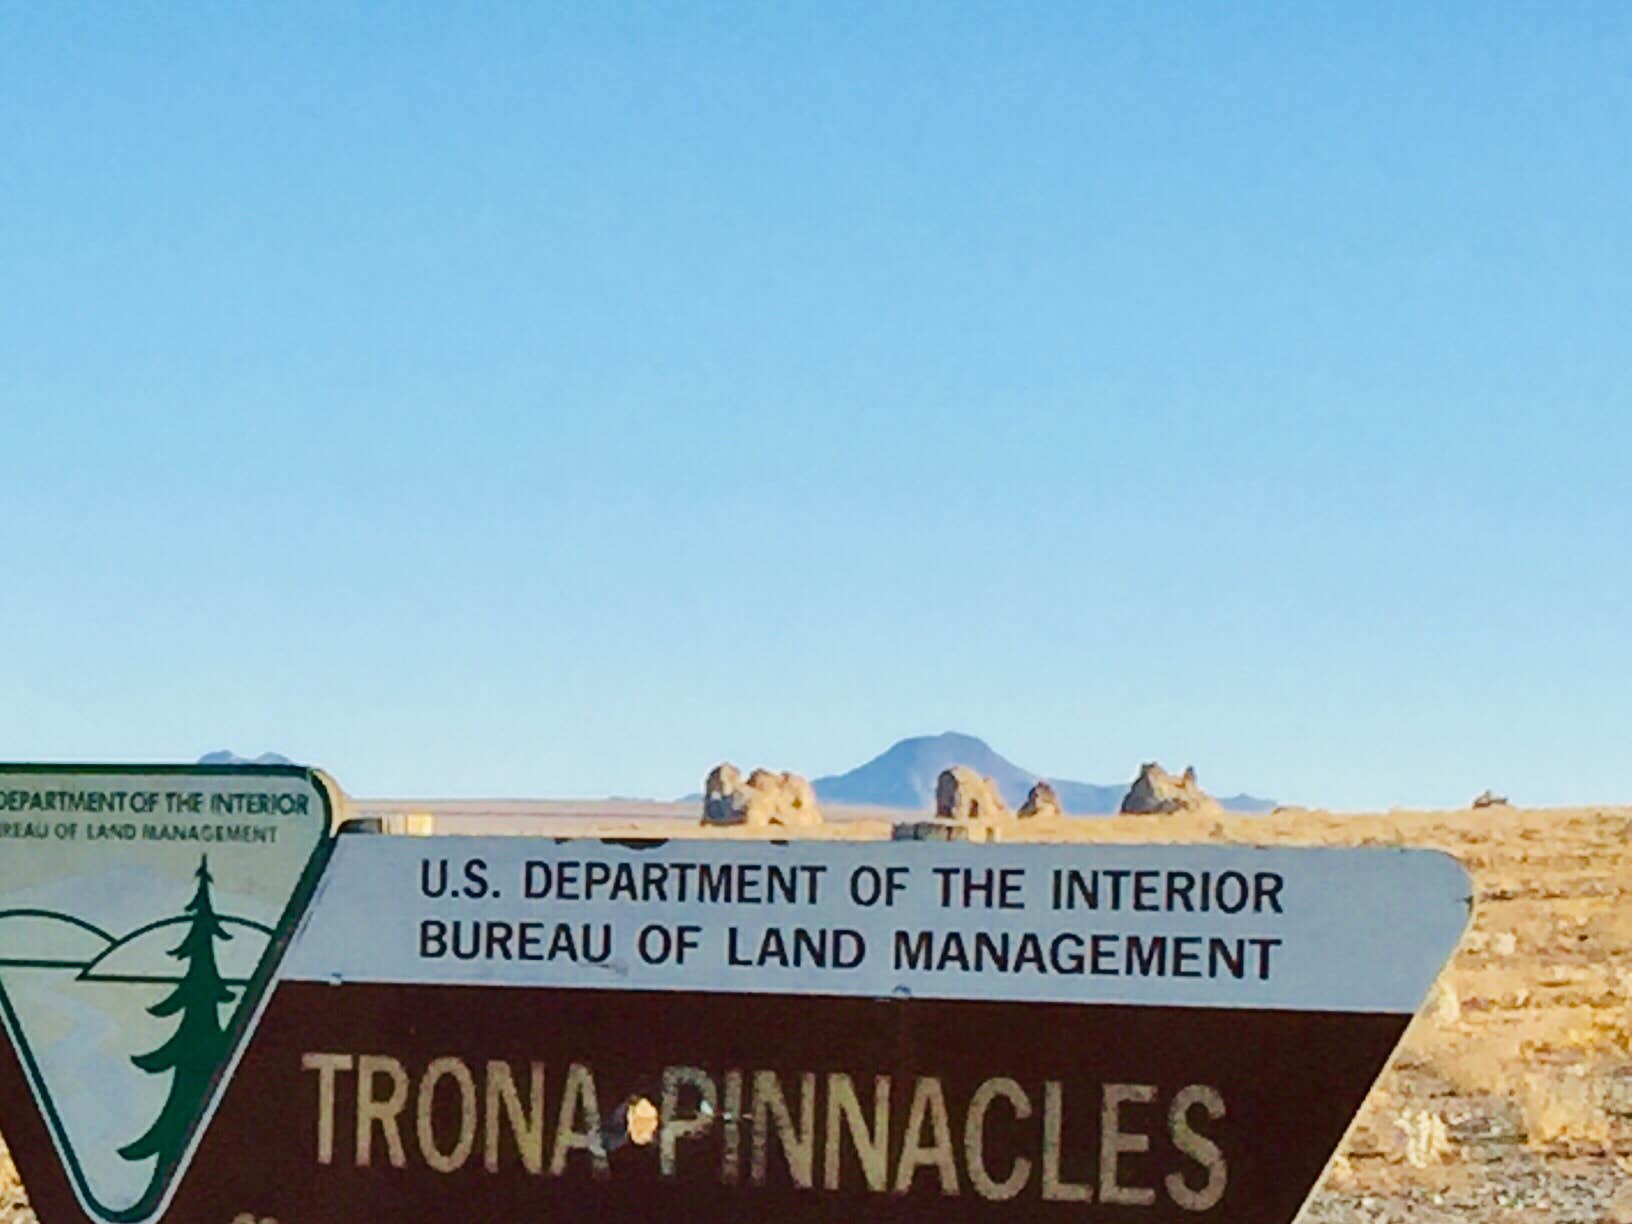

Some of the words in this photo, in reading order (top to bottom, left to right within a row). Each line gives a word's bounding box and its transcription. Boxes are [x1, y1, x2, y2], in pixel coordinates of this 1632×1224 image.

[125, 792, 157, 815] OF
[165, 791, 205, 815] THE
[210, 792, 310, 817] INTERIOR
[54, 822, 78, 841] OF
[86, 823, 138, 842] LAND
[142, 824, 278, 844] MANAGEMENT
[421, 860, 500, 900] U.S.
[523, 861, 827, 907] DEPARTMENT
[850, 866, 910, 907] OF
[931, 868, 1026, 909] THE
[1051, 871, 1285, 914] INTERIOR
[419, 921, 614, 966] BUREAU
[637, 926, 701, 966] OF
[726, 928, 866, 970] LAND
[892, 931, 1282, 980] MANAGEMENT
[302, 1052, 611, 1176] TRONA
[659, 1066, 1228, 1212] PINNACLES
